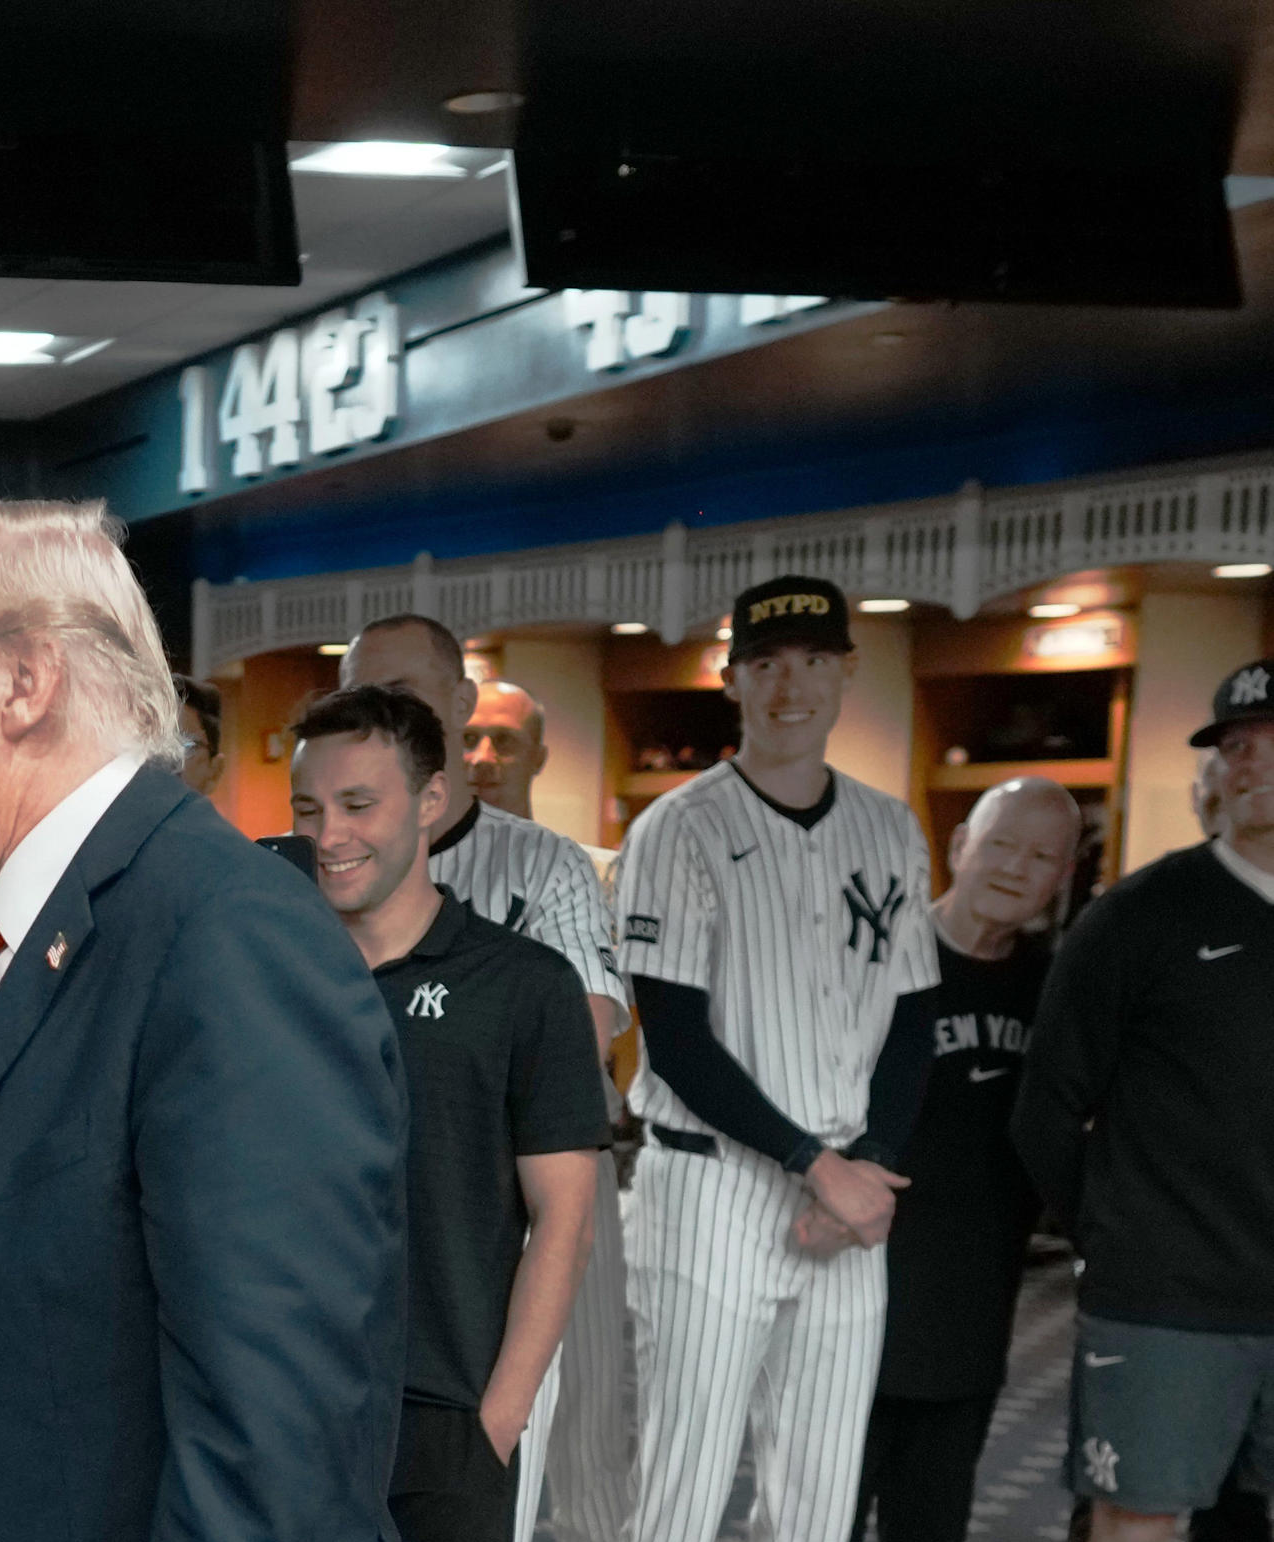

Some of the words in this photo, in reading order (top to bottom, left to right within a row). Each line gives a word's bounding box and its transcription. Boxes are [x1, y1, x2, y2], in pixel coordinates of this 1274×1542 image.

[750, 594, 830, 624] NYPD
[1231, 667, 1270, 704] NY
[843, 871, 905, 962] NY
[405, 981, 450, 1020] NY
[933, 1013, 980, 1056] EW
[985, 1014, 1034, 1054] YO
[1083, 1436, 1120, 1493] NY
